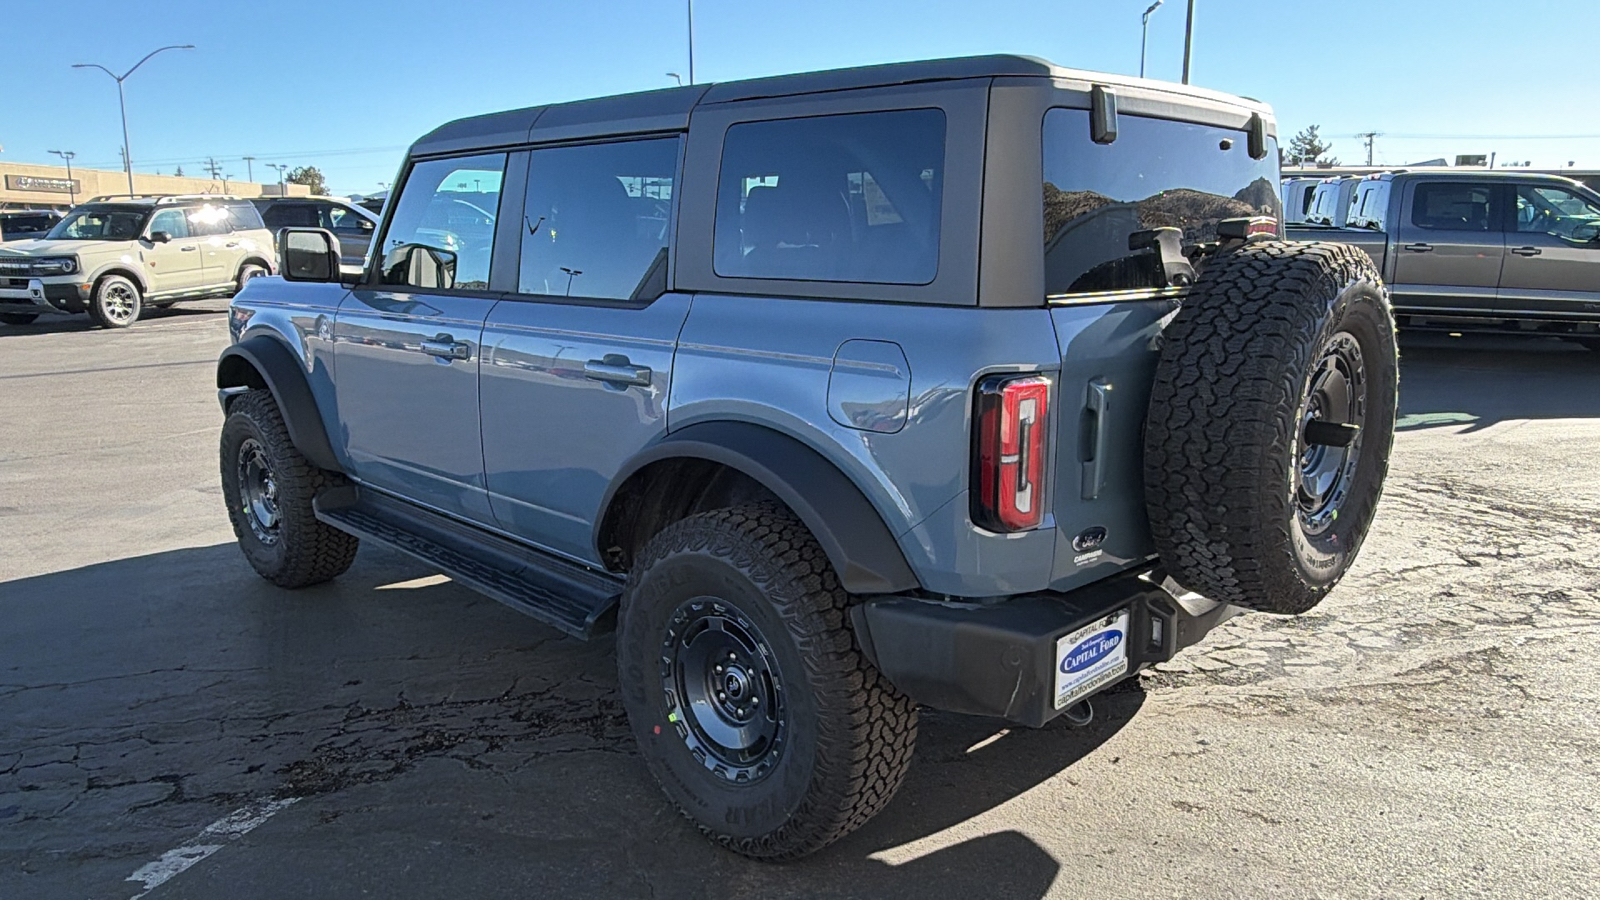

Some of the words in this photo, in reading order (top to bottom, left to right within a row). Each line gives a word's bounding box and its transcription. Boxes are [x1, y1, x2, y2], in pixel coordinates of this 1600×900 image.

[1075, 623, 1098, 641] CAPITAL
[1064, 646, 1098, 671] CAPITAL
[1099, 635, 1119, 653] FORD
